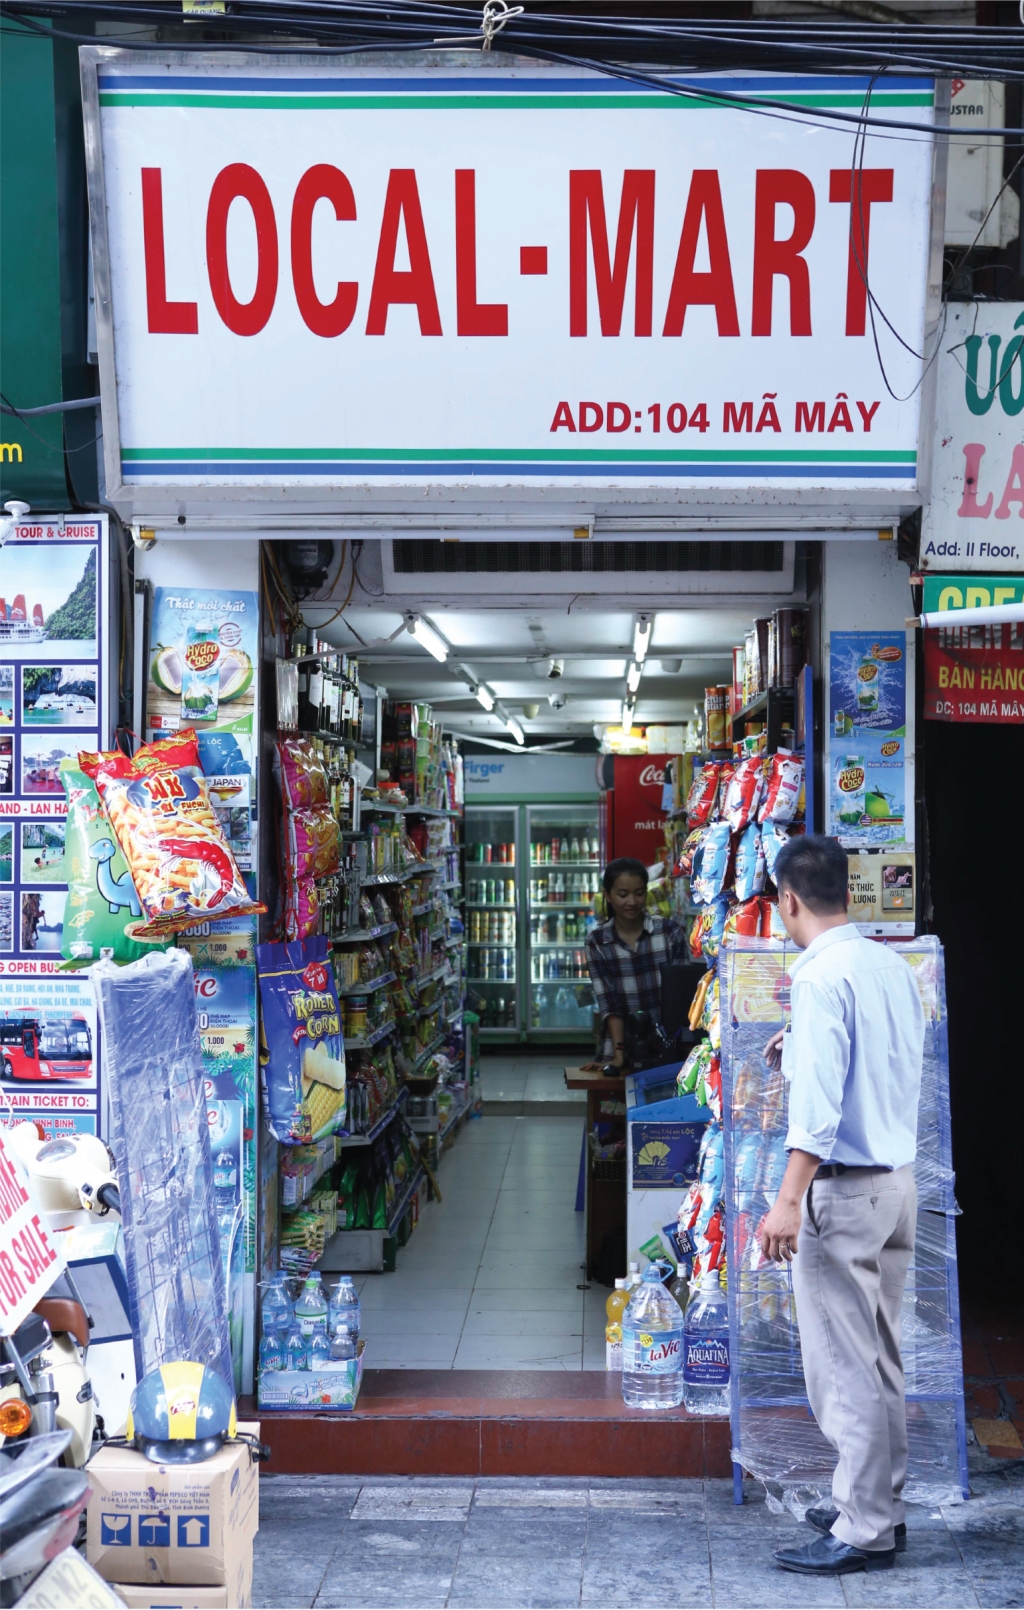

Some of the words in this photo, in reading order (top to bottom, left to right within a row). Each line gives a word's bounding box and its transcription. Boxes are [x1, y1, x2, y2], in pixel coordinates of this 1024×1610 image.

[723, 393, 781, 432] MÃ
[795, 393, 880, 432] MÂY
[15, 526, 43, 539] TOUR
[47, 527, 55, 537] &
[58, 526, 95, 539] CRUISE
[925, 541, 961, 557] Add:
[979, 542, 1019, 561] Floor,
[187, 644, 218, 658] Hydro
[188, 654, 214, 668] Coco
[939, 661, 975, 689] BÁN
[959, 703, 977, 716] 104
[980, 700, 998, 716] MÃ
[839, 768, 865, 781] Hydro
[211, 778, 243, 788] JAPAN
[841, 777, 863, 792] Coco
[30, 804, 51, 814] LAN
[181, 801, 205, 810] FUCHI
[8, 961, 37, 973] OPEN
[306, 1014, 341, 1041] CORN
[207, 1036, 225, 1045] 1.000
[33, 1095, 69, 1107] TICKET
[72, 1096, 89, 1107] TO:
[11, 1214, 57, 1285] SALE
[687, 1344, 730, 1366] AQUAFINA
